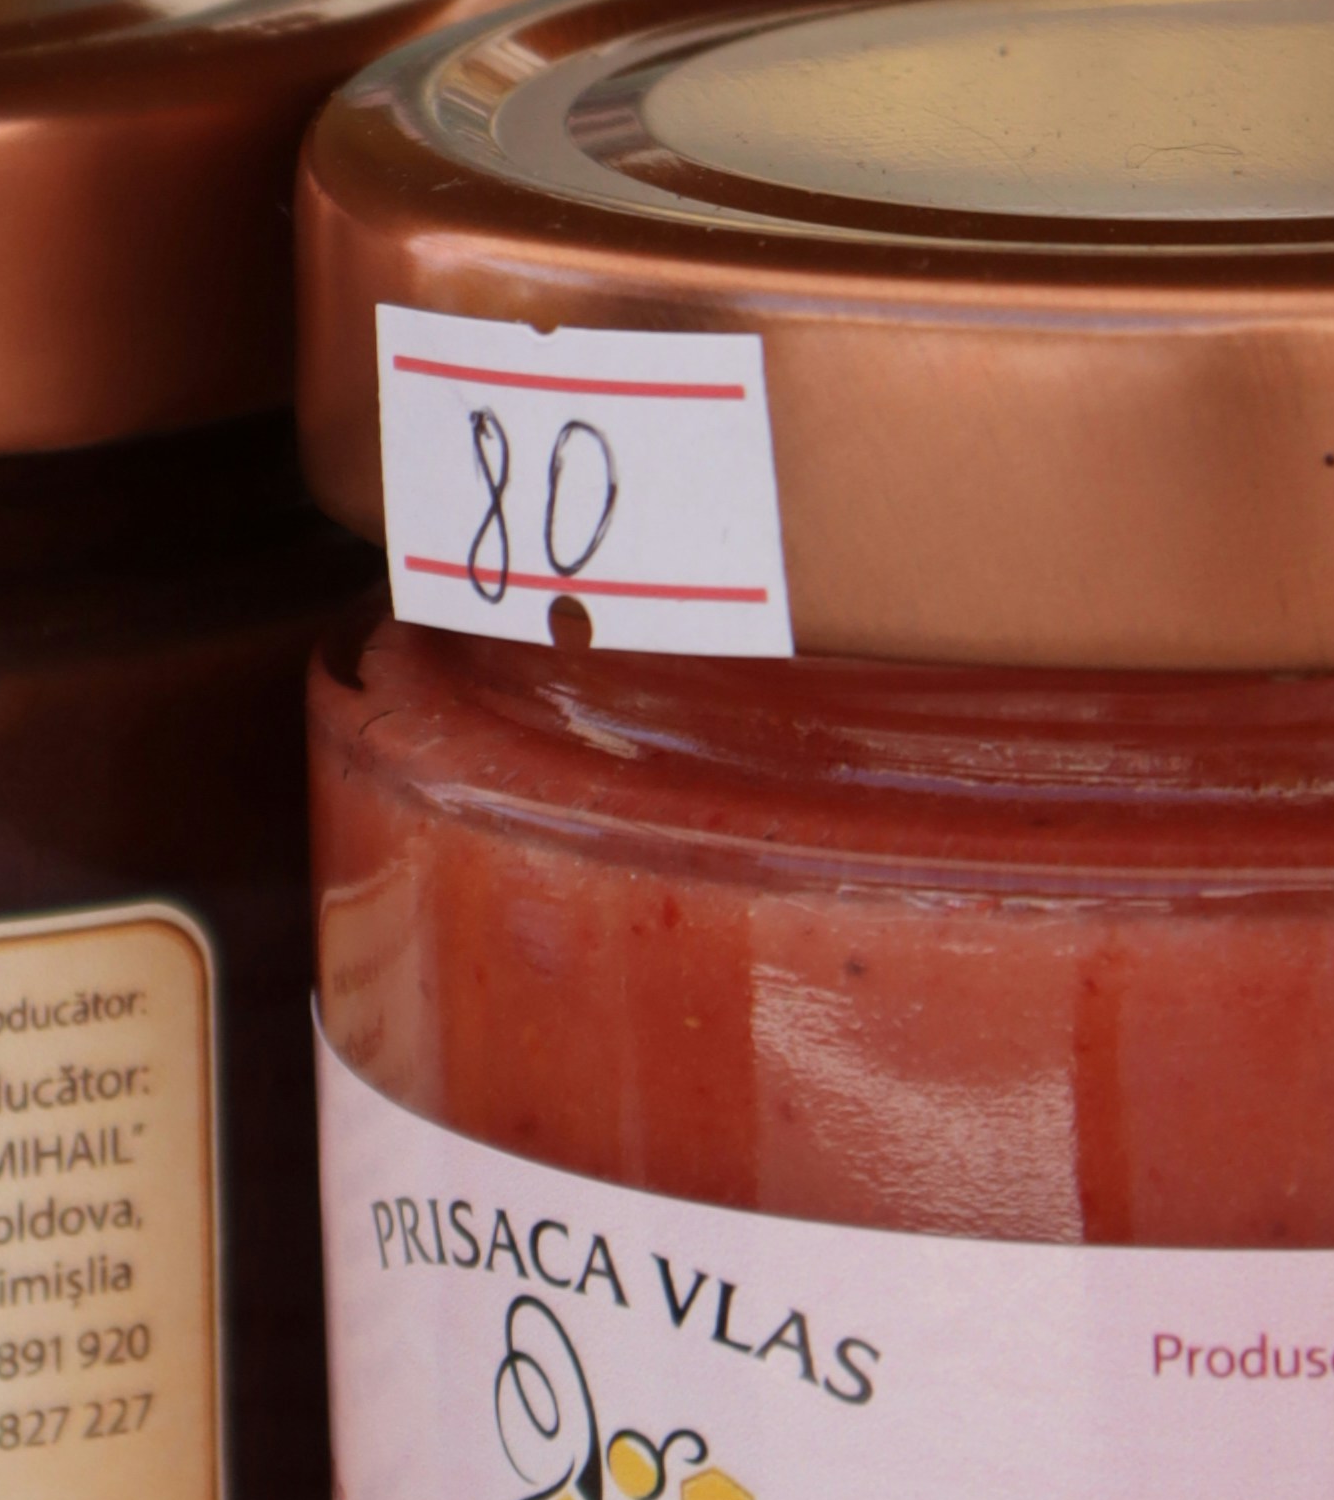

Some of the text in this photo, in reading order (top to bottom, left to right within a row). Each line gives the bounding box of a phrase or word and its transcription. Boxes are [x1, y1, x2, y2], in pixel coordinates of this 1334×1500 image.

[468, 405, 617, 604] 80
[76, 1323, 152, 1369] 920
[371, 1195, 882, 1406] PRISACA VLAS
[82, 1392, 155, 1441] 227
